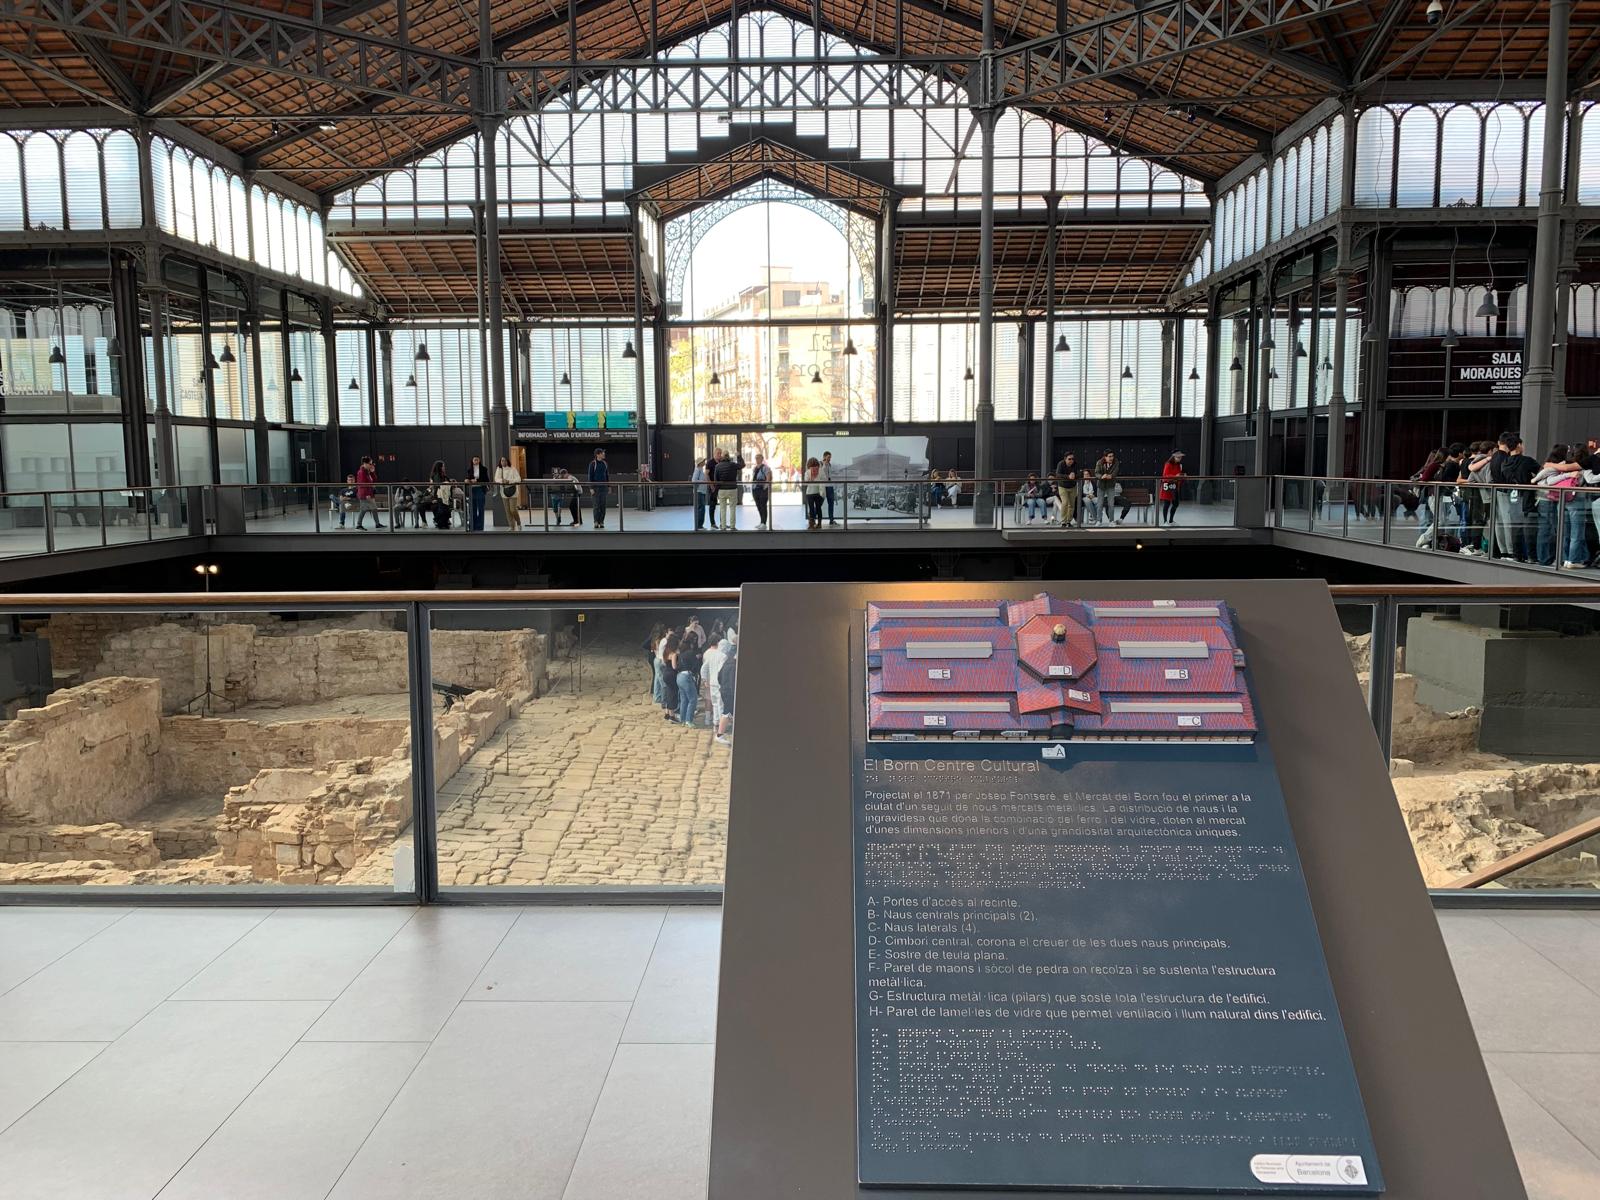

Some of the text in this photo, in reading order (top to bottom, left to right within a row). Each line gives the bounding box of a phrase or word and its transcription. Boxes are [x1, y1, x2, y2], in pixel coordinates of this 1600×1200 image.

[1491, 352, 1522, 365] SALA
[1460, 367, 1522, 380] MORAGUES
[942, 669, 949, 678] E
[1063, 666, 1071, 675] D
[1179, 669, 1186, 679] B
[1082, 692, 1089, 701] B
[1192, 716, 1201, 725] C
[1056, 748, 1064, 757] A
[863, 759, 1040, 772] El Born Centre Cultural
[865, 791, 910, 802] Projectat
[913, 792, 923, 802] el
[926, 792, 951, 802] 1871
[955, 793, 973, 803] per
[976, 792, 1007, 803] Josep
[1063, 792, 1072, 802] el
[1076, 792, 1112, 802] Mercat
[1115, 792, 1131, 802] del
[1134, 792, 1159, 802] Born
[1162, 792, 1179, 802] fou
[1182, 792, 1191, 802] el
[1195, 792, 1228, 804] primer
[1241, 792, 1252, 802] la
[865, 801, 893, 811] ciutat
[896, 801, 918, 811] d'un
[921, 803, 953, 815] seguit
[955, 803, 969, 813] de
[972, 804, 997, 813] nous
[1001, 803, 1043, 813] mercats
[1103, 803, 1116, 813] La
[1176, 803, 1190, 813] de
[1192, 803, 1219, 813] naus
[1228, 803, 1238, 813] la
[865, 813, 926, 825] ingravidesa
[928, 815, 949, 825] que
[981, 814, 991, 824] la
[1057, 814, 1073, 824] del
[1077, 814, 1102, 824] ferro
[1111, 814, 1129, 824] del
[1163, 814, 1193, 824] doten
[1196, 814, 1206, 824] el
[1208, 816, 1246, 826] mercat
[865, 824, 900, 835] d'unes
[903, 825, 963, 835] dimensions
[966, 825, 1010, 836] interiors
[1018, 826, 1048, 836] d'una
[1051, 826, 1113, 837] grandiositat
[867, 896, 880, 907] A-
[884, 896, 918, 907] Portes
[967, 896, 977, 907] al
[980, 898, 1021, 908] recinte.
[868, 909, 1039, 923] B- Naus centrals principals (2).
[868, 922, 881, 932] C-
[884, 922, 914, 932] Naus
[917, 922, 958, 933] laterals
[868, 936, 881, 946] D-
[977, 939, 1016, 947] corona
[1019, 937, 1029, 947] el
[1033, 939, 1069, 948] creuer
[1072, 938, 1086, 948] de
[1089, 938, 1107, 948] les
[1110, 938, 1138, 948] dues
[1141, 940, 1169, 949] naus
[1173, 938, 1231, 950] principals.
[868, 949, 1009, 962] E- Sostre de teula plana.
[868, 962, 881, 972] F-
[884, 962, 915, 972] Paret
[918, 963, 932, 973] de
[936, 965, 975, 974] maons
[1018, 963, 1032, 974] de
[1036, 964, 1069, 976] pedra
[1073, 967, 1087, 975] on
[1090, 965, 1133, 975] recolza
[1143, 967, 1156, 975] se
[1160, 966, 1209, 976] sustenta
[1212, 965, 1276, 977] l'estructura
[869, 991, 883, 1001] G-
[887, 991, 946, 1001] Estructura
[1011, 992, 1051, 1004] (pilars)
[1055, 995, 1077, 1005] que
[1115, 993, 1138, 1004] tota
[1140, 993, 1205, 1004] l'estructura
[1208, 993, 1223, 1004] de
[1226, 993, 1270, 1005] l'edifici.
[869, 1006, 883, 1017] H-
[886, 1006, 918, 1017] Paret
[921, 1006, 936, 1017] de
[995, 1007, 1010, 1018] de
[1013, 1007, 1042, 1018] vidre
[1045, 1010, 1068, 1020] que
[1071, 1009, 1112, 1020] permet
[1181, 1009, 1206, 1020] llum
[1209, 1009, 1251, 1020] natural
[1254, 1009, 1279, 1020] dins
[1282, 1009, 1327, 1021] l'edifici.
